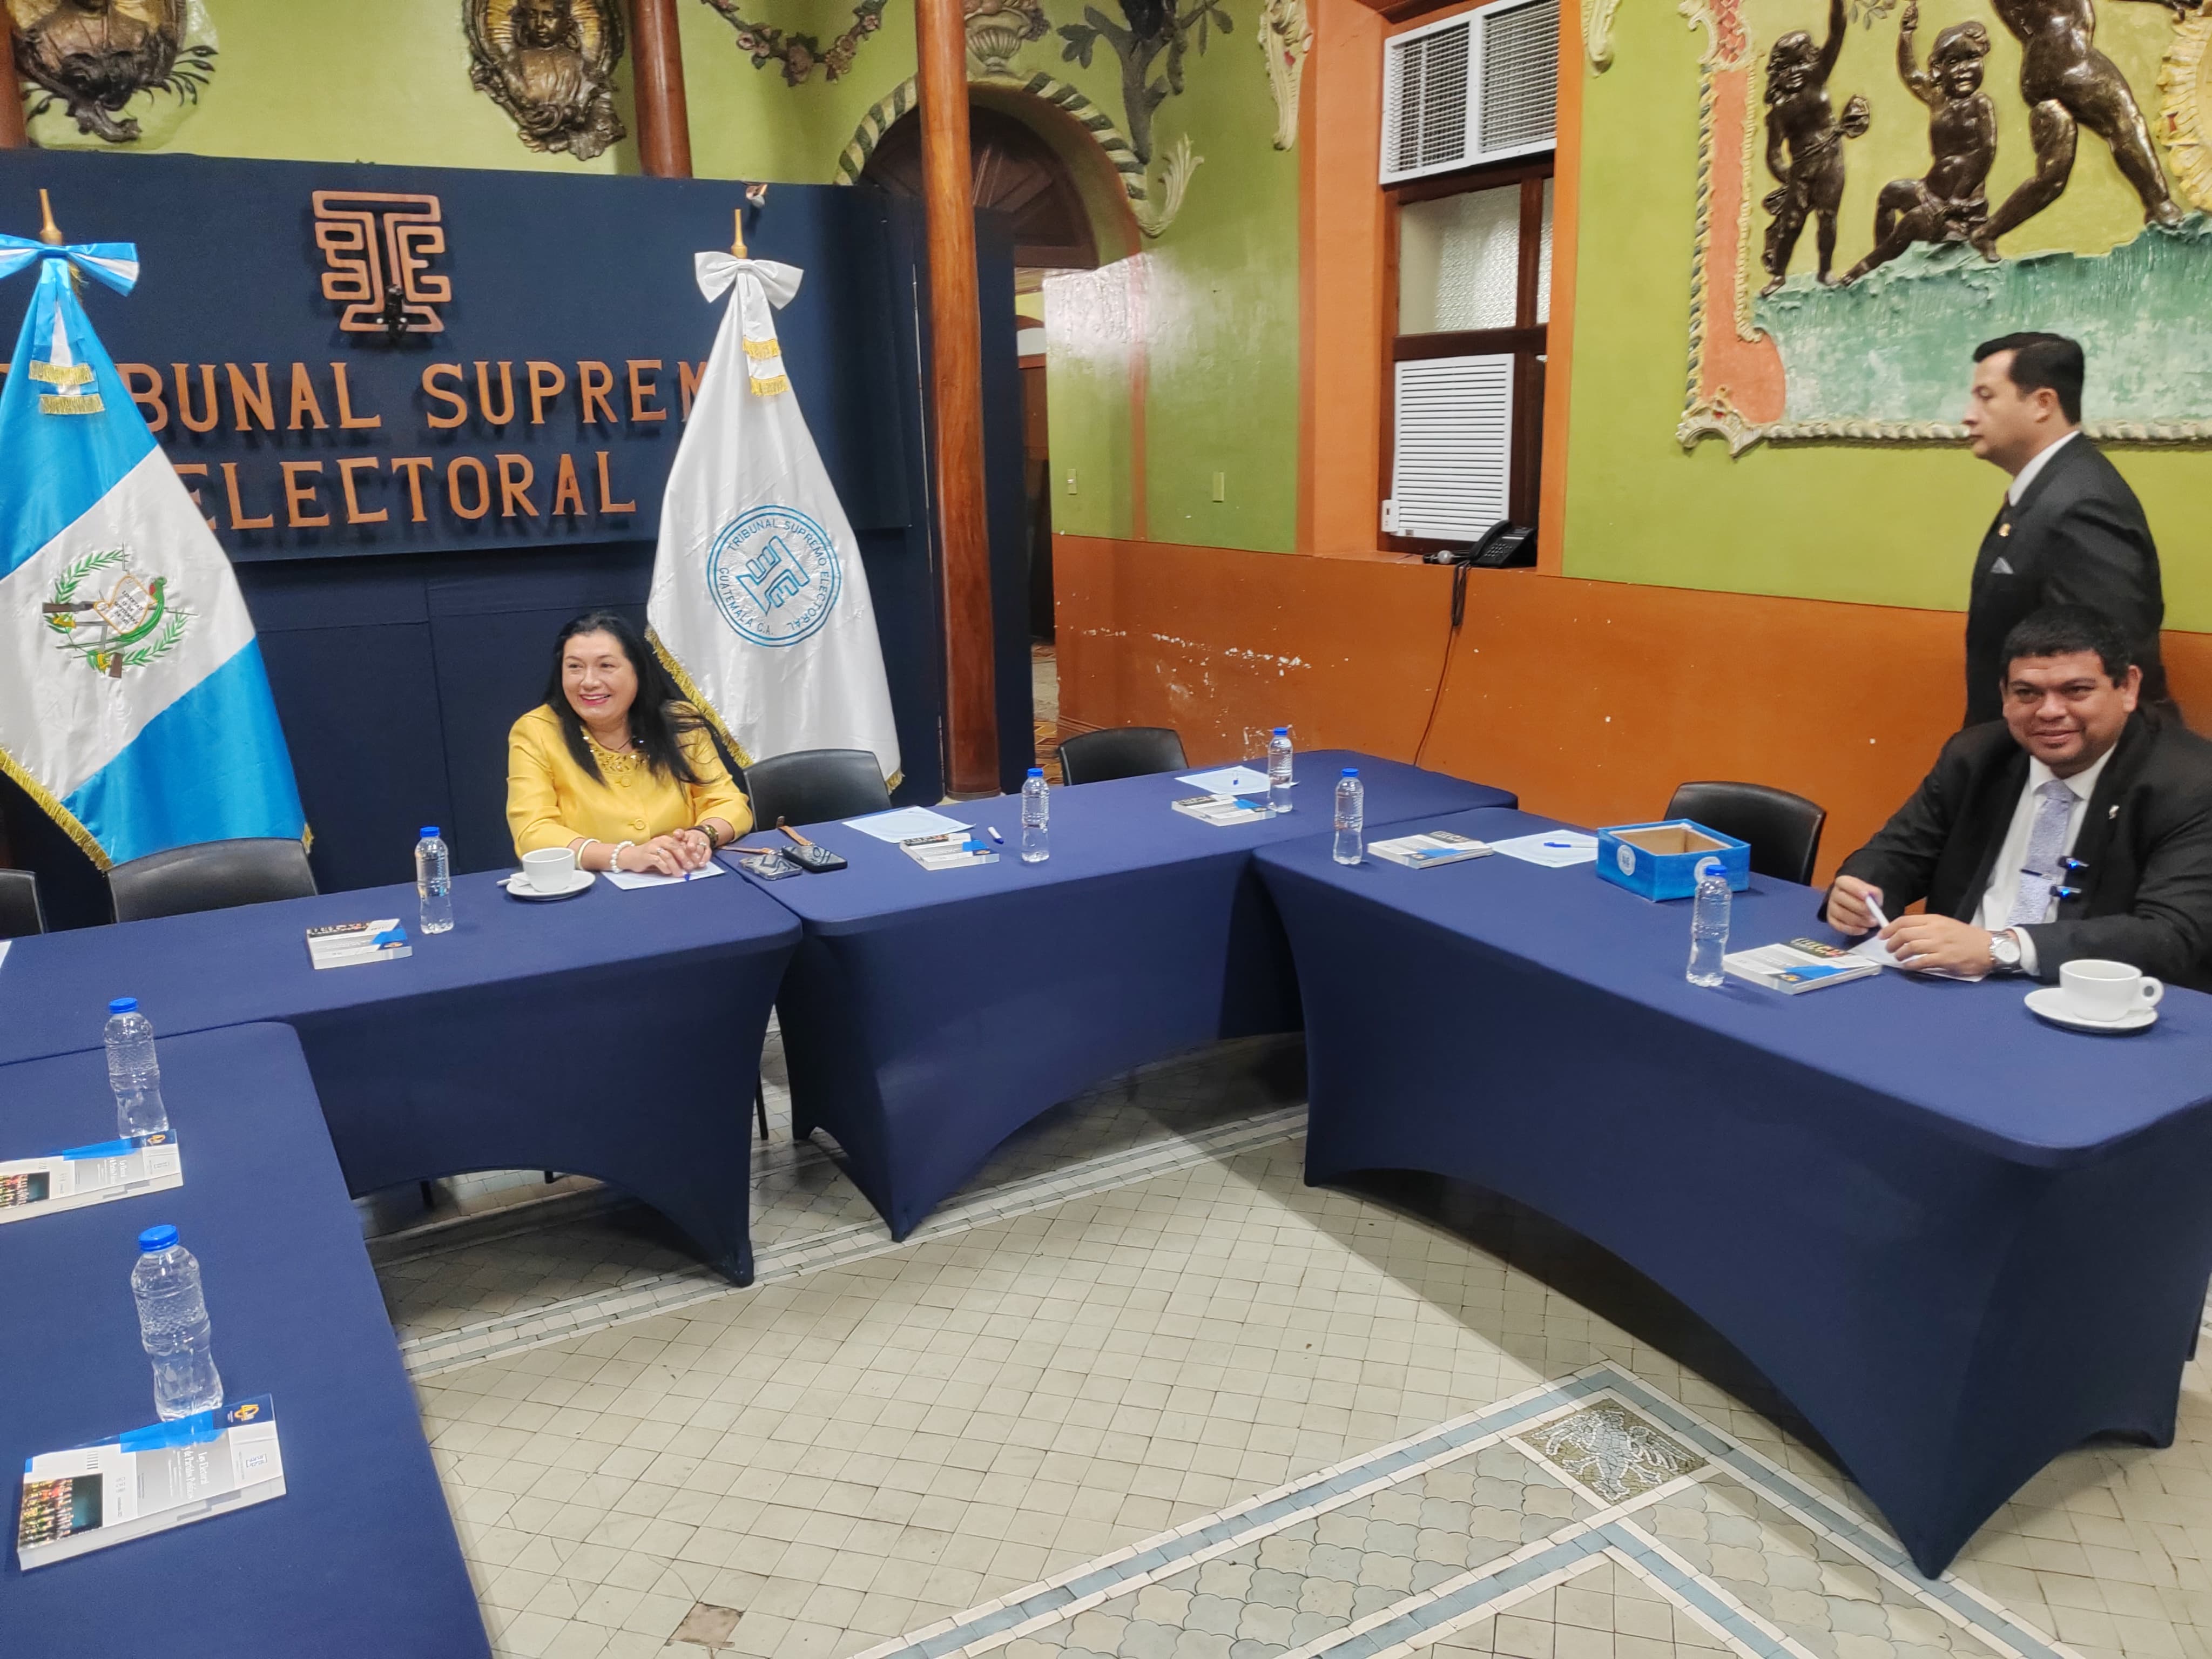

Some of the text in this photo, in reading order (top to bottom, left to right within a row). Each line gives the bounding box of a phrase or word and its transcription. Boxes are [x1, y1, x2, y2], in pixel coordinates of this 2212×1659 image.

[0, 359, 709, 432] BUNAL SUPREM
[719, 568, 754, 627] GUATEMALA
[727, 518, 829, 631] TRIBUNAL SUPREMO ELECTORAL
